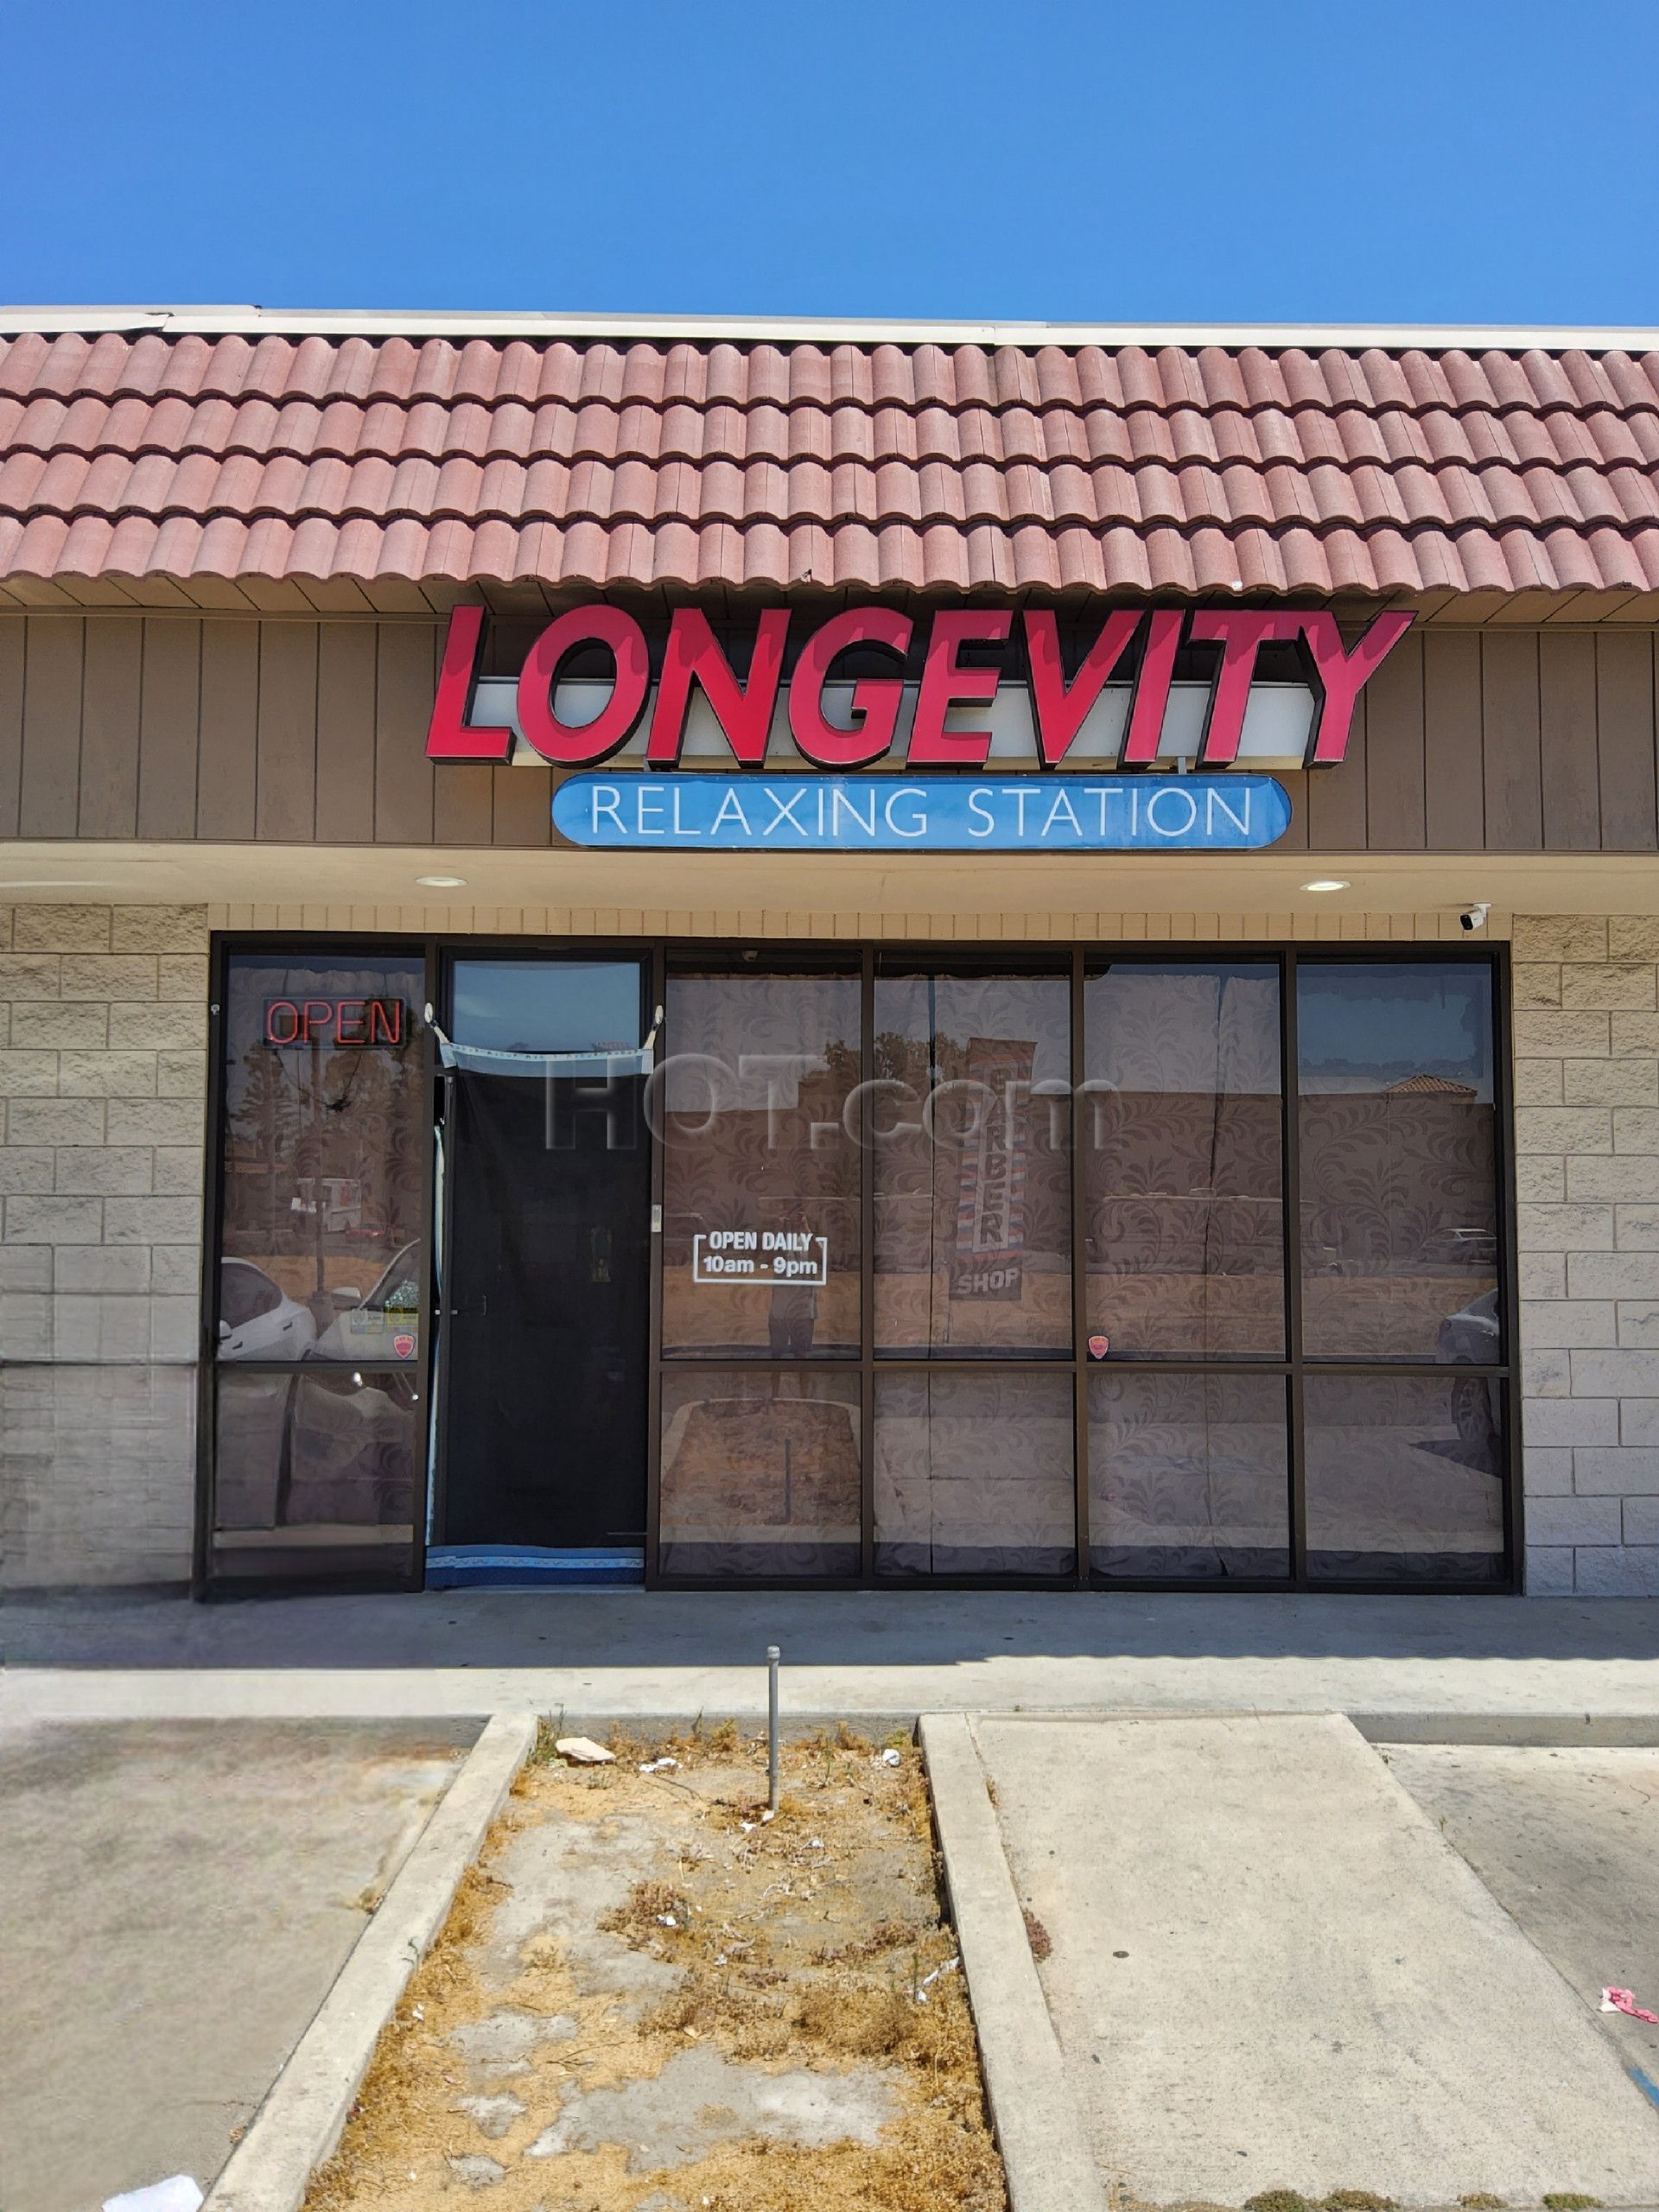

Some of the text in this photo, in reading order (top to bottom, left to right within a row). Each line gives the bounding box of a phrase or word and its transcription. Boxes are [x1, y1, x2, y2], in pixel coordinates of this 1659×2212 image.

[426, 605, 1419, 770] LONGEVITY
[590, 785, 1251, 838] RELAXING STATION
[266, 1000, 401, 1045] OPEN
[709, 1230, 814, 1252] OPEN DAILY
[702, 1255, 755, 1274] 10am
[772, 1256, 818, 1278] 9pm
[957, 1268, 1020, 1295] SHOP
